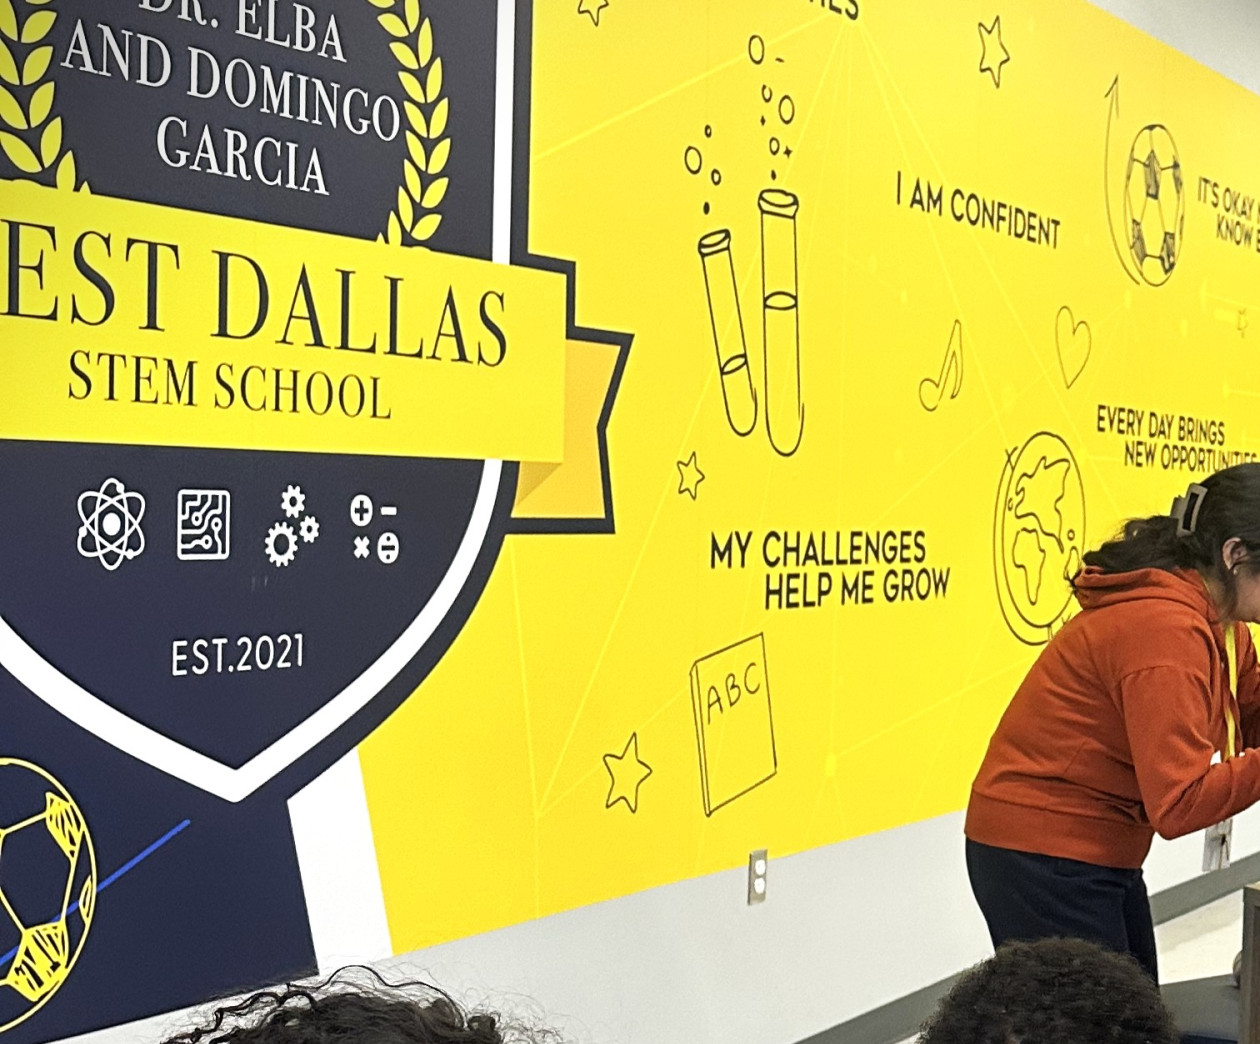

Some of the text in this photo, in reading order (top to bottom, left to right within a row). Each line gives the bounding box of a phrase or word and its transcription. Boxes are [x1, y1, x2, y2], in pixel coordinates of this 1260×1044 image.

[235, 0, 348, 63] ELBA
[60, 18, 400, 142] AND DOMINGO
[157, 116, 330, 196] GARCIA
[896, 170, 1061, 250] I AM CONFIDENT
[1216, 213, 1254, 247] KNOW
[1222, 186, 1255, 222] OKAY
[210, 250, 508, 368] DALLAS
[68, 350, 392, 420] STEM SCHOOL
[1097, 404, 1226, 447] EVERY DAY BRINGS
[1124, 440, 1157, 468] NEW
[710, 530, 926, 570] MY CHALLENGES
[765, 567, 951, 611] HELP ME GROW
[172, 633, 304, 677] EST.2021
[707, 661, 761, 726] ABC
